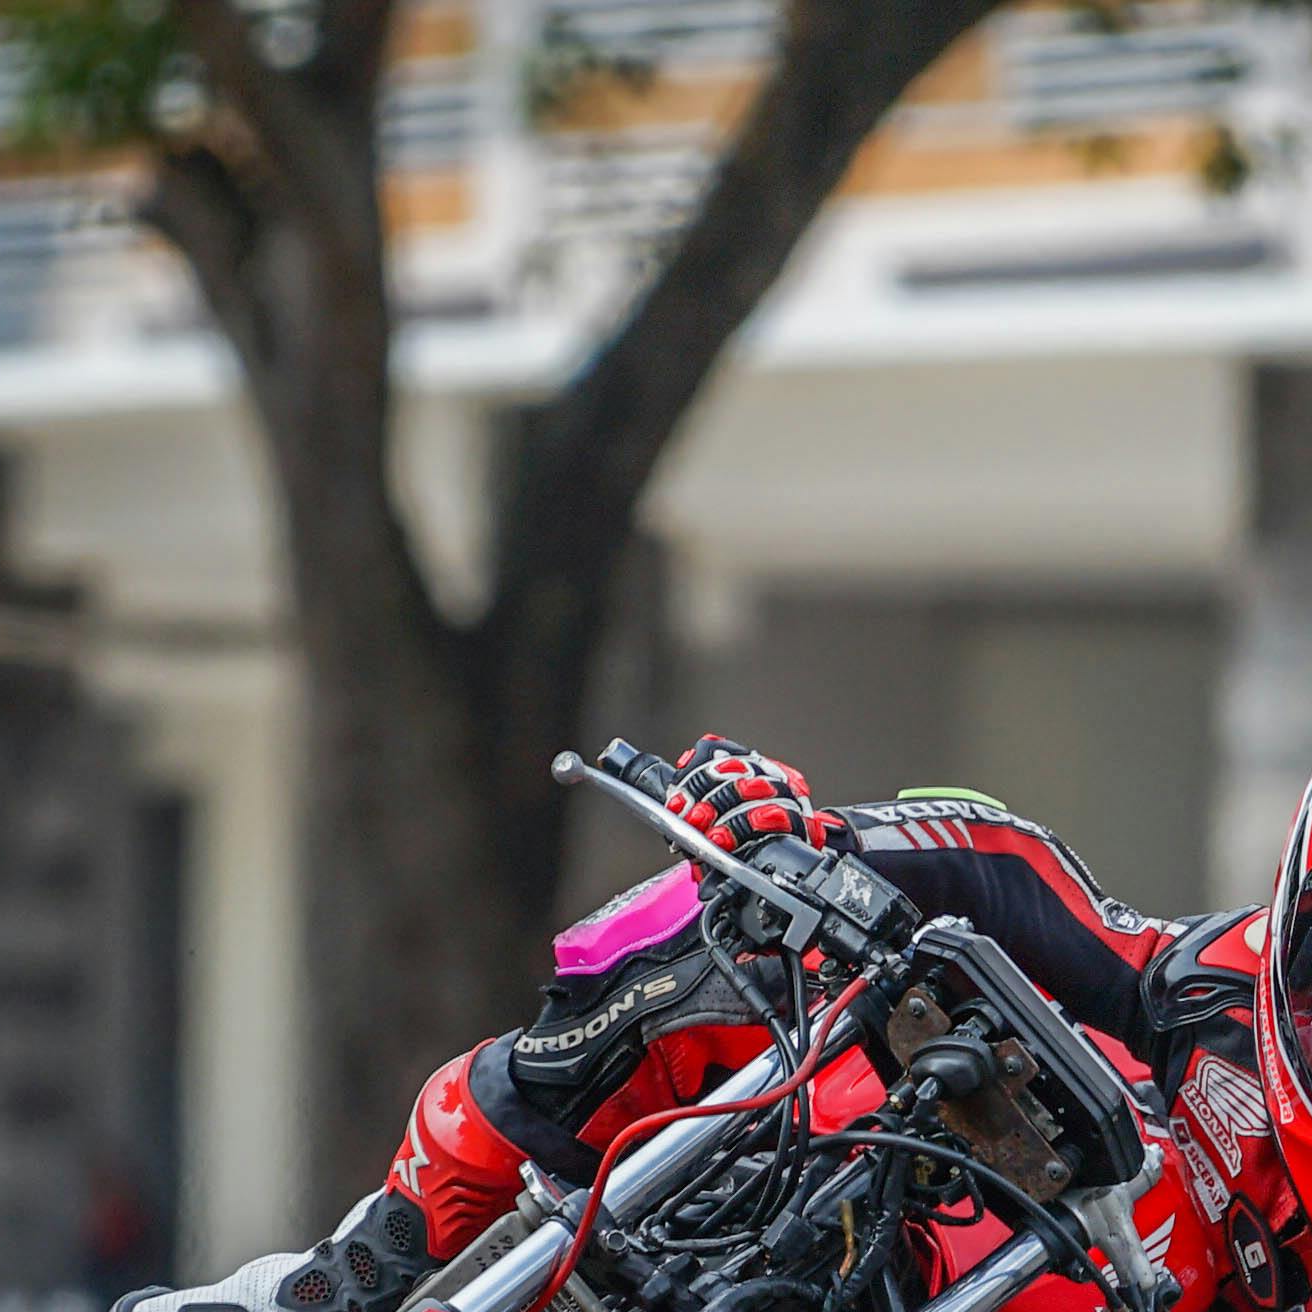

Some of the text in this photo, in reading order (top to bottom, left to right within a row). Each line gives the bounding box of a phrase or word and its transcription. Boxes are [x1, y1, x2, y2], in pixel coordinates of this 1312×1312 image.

[514, 973, 677, 1054] ORDON'S
[1185, 1083, 1239, 1170] HONDA
[1244, 1242, 1267, 1270] G
